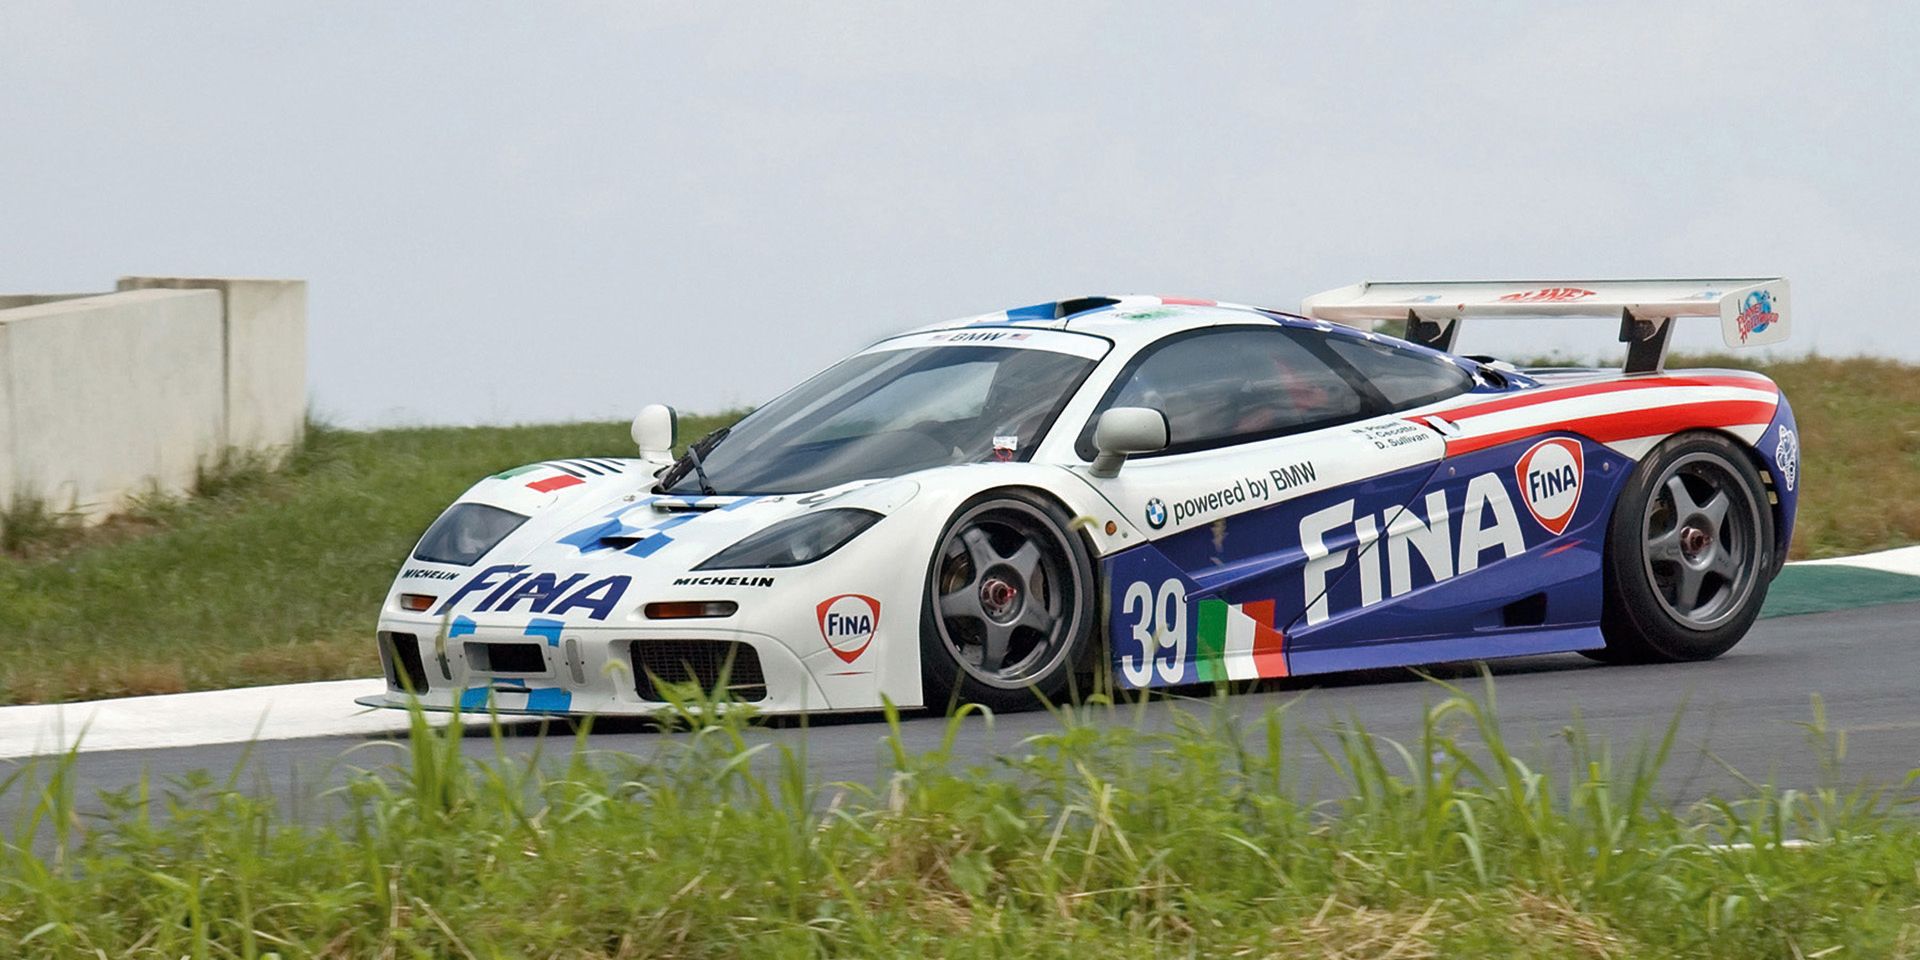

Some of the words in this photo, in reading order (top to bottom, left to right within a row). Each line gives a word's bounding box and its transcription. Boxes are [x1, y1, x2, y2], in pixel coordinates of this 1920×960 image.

[949, 332, 1006, 341] BMW
[1374, 441, 1389, 449] D.
[1387, 433, 1429, 447] Sullivan
[1173, 481, 1245, 525] powered
[1245, 478, 1269, 501] by
[1269, 461, 1315, 491] BMW
[1529, 464, 1577, 503] FINA
[1299, 472, 1525, 625] FINA
[402, 569, 460, 580] MICHELIN
[672, 577, 775, 587] MICHELIN
[433, 564, 632, 621] FINA
[828, 613, 871, 636] FINA
[1121, 577, 1186, 685] 39
